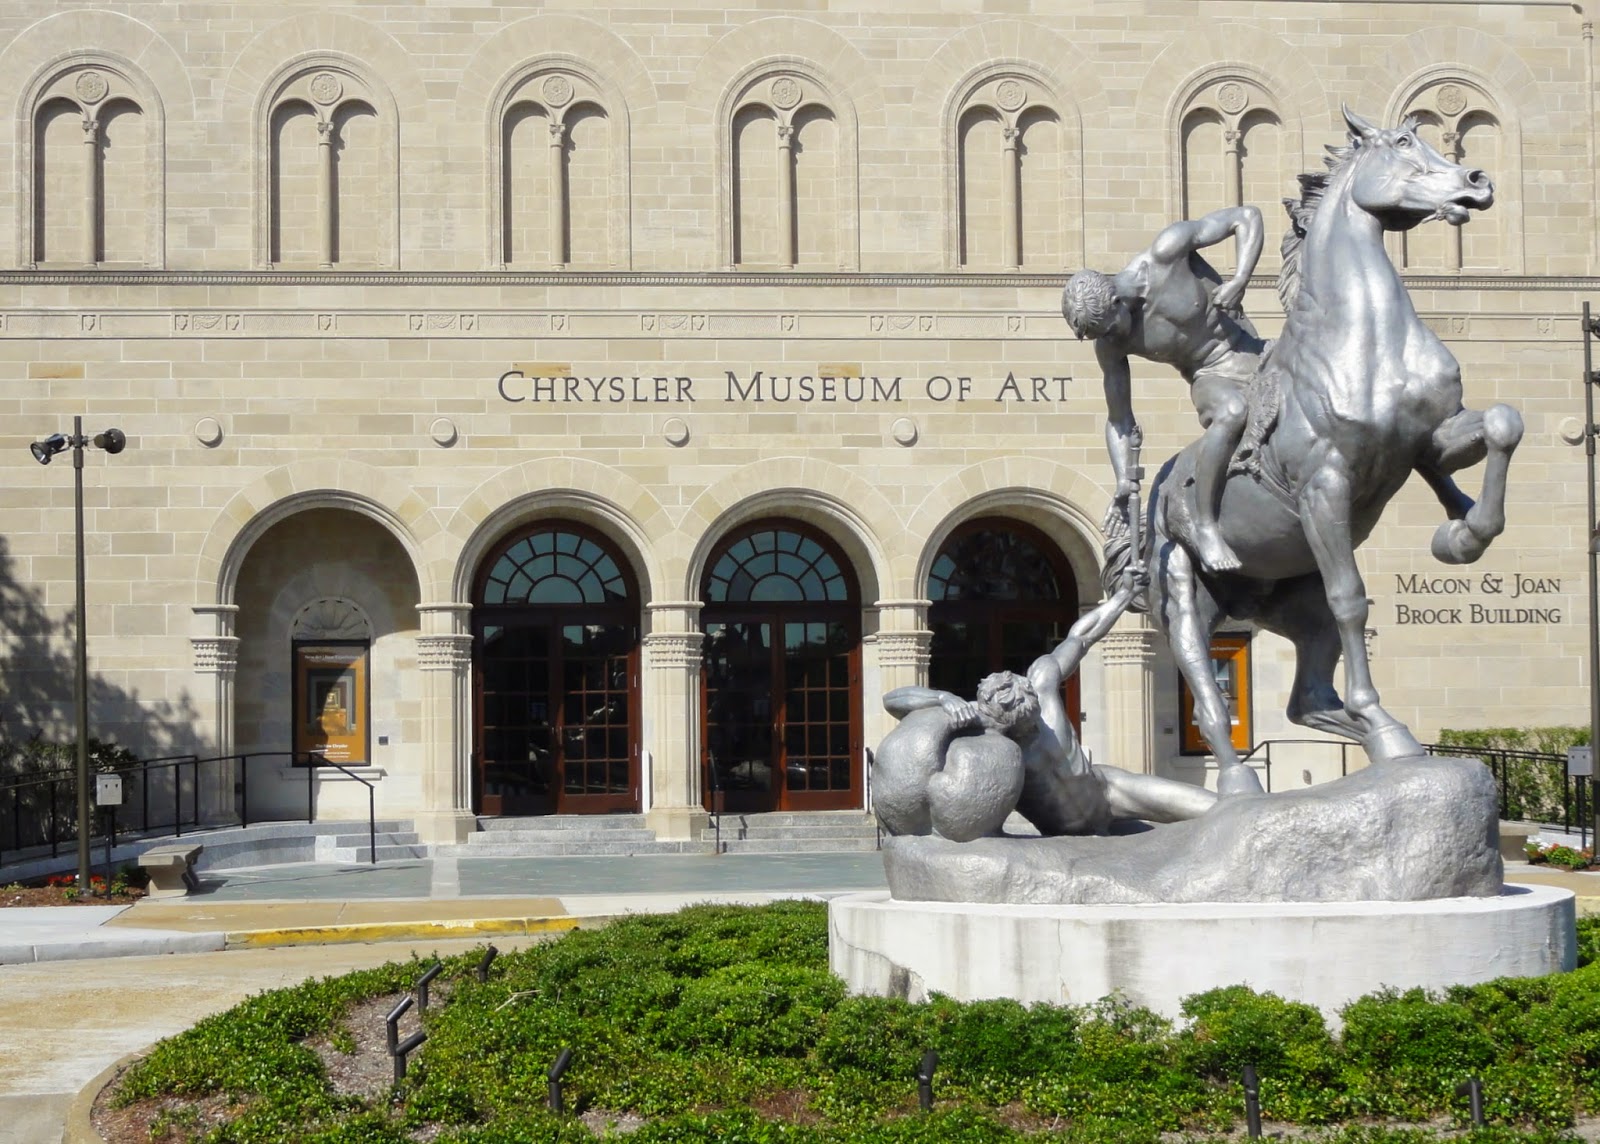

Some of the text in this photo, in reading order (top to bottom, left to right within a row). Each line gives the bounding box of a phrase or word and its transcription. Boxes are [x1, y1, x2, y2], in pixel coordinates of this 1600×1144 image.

[498, 371, 1073, 403] CHRYSLER MUSEUM OF ART
[1395, 573, 1561, 599] MACON & JOAN
[1395, 603, 1562, 625] BROCK BUILDING
